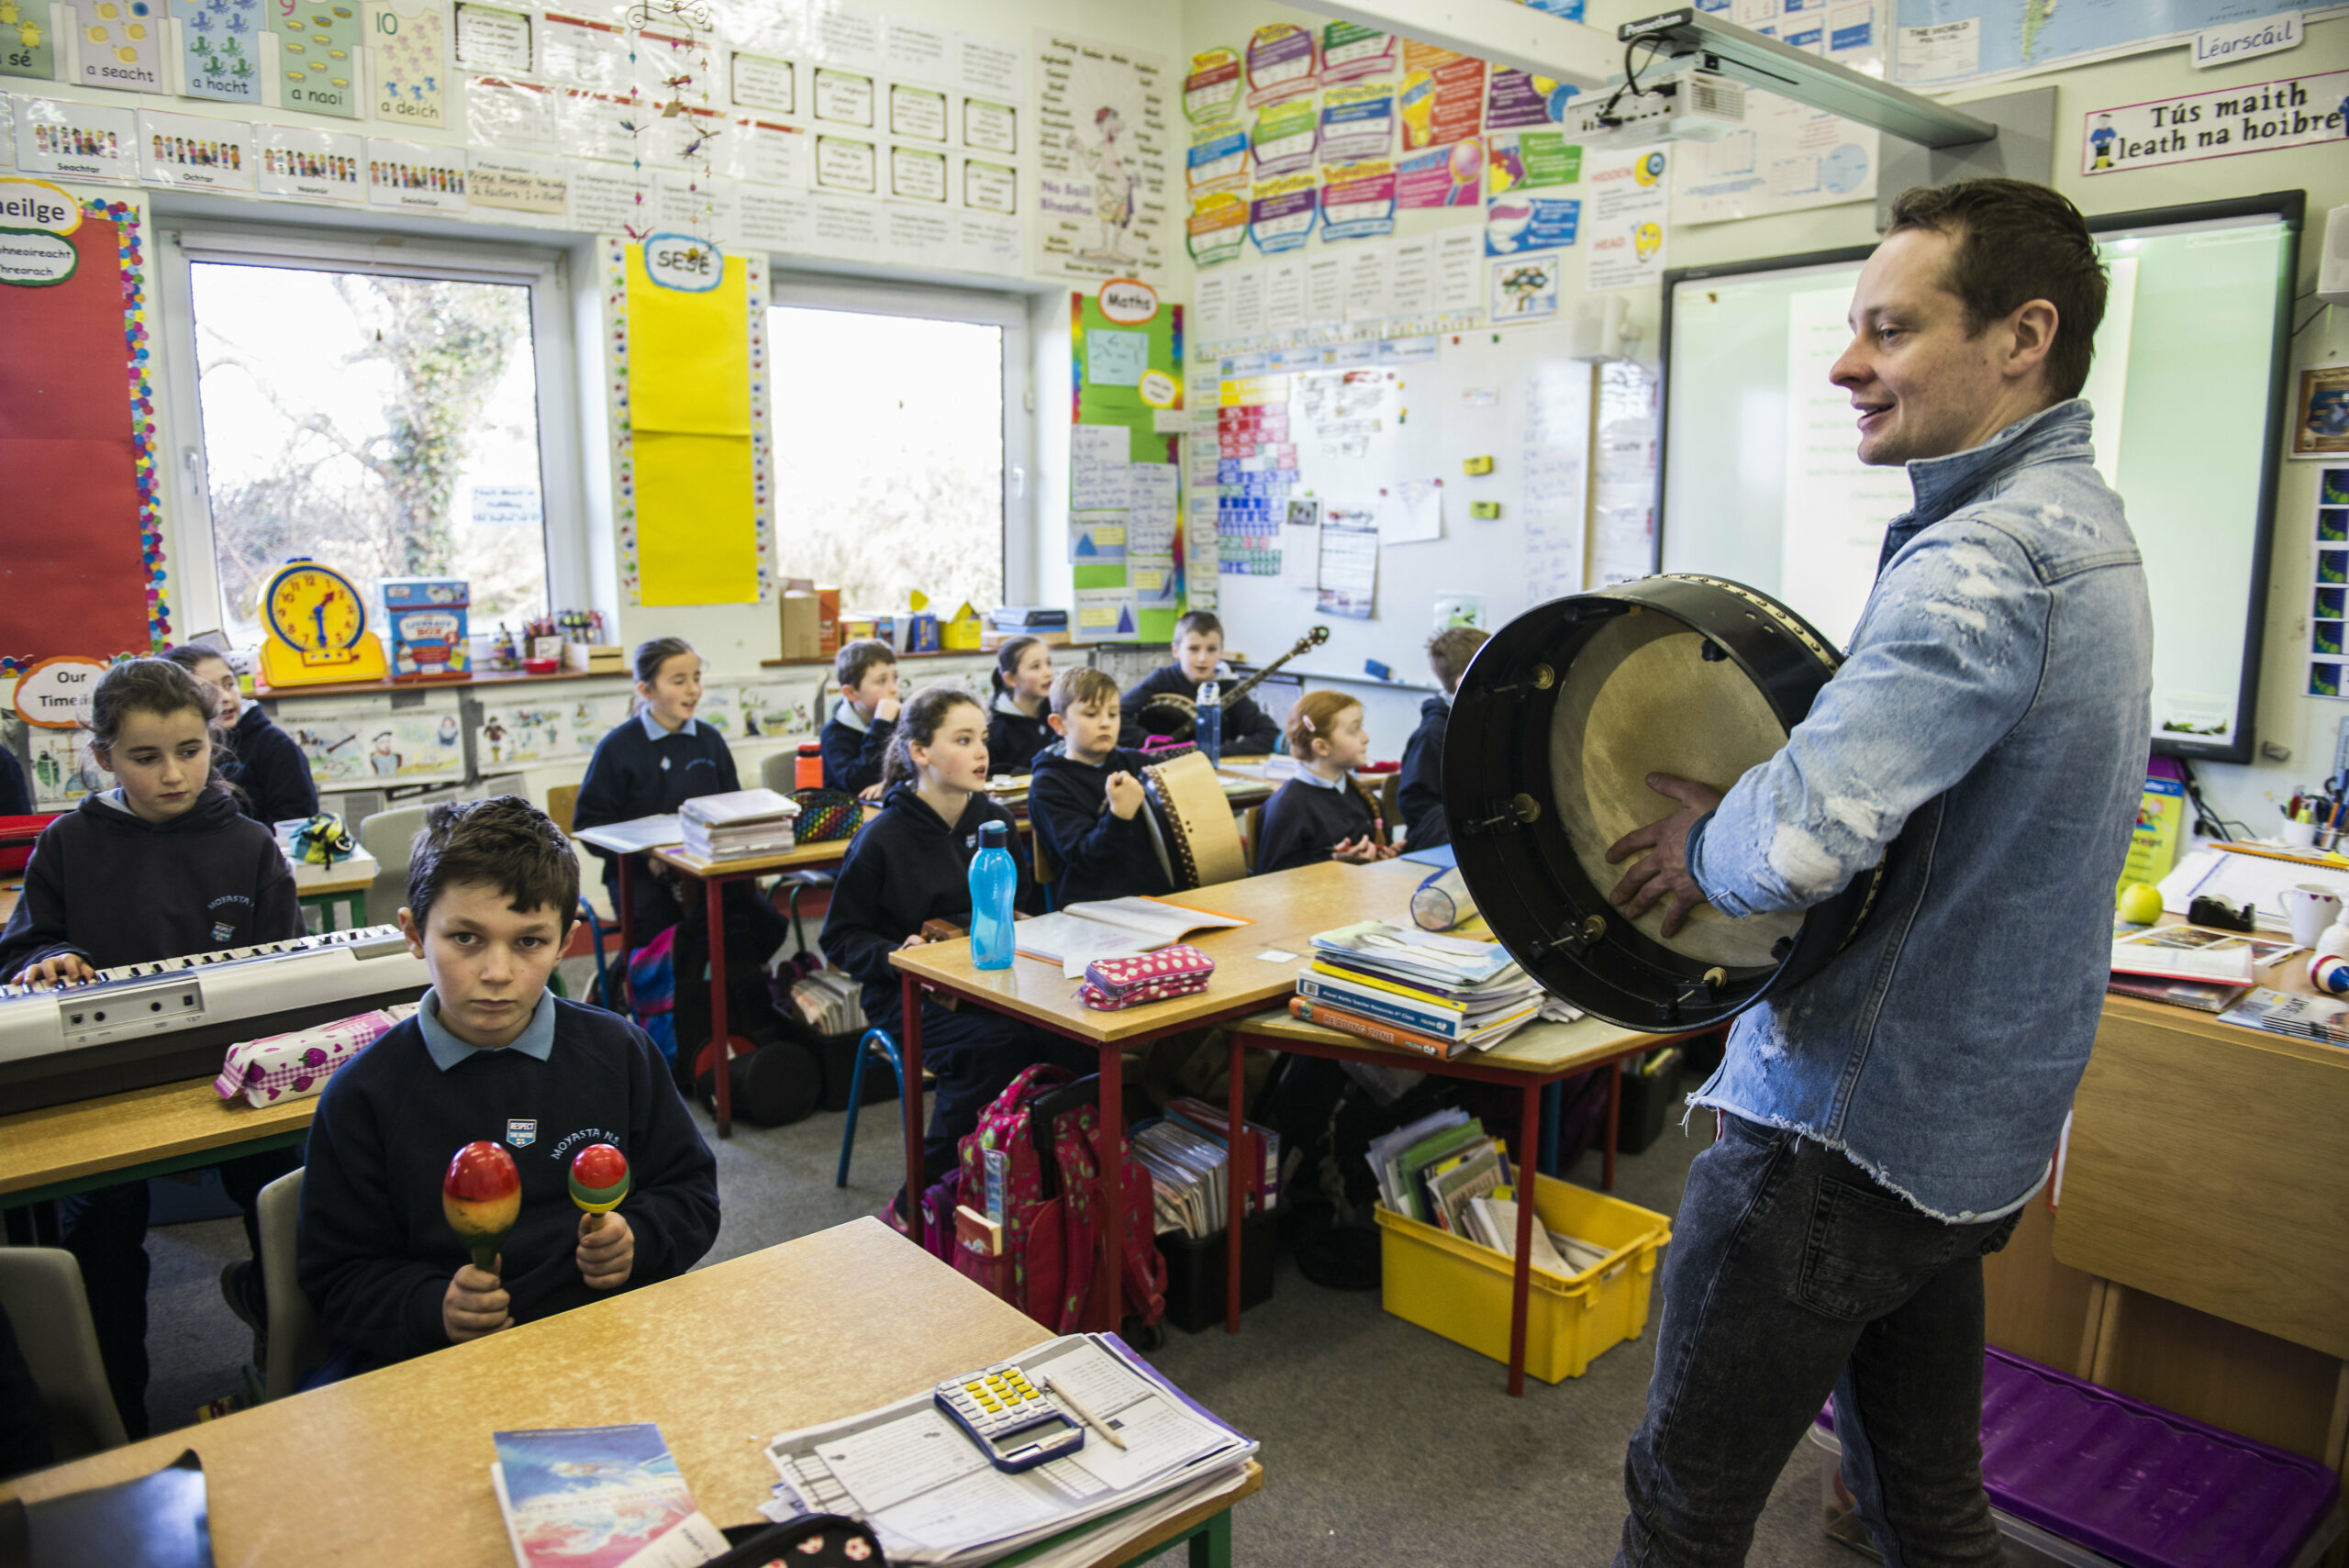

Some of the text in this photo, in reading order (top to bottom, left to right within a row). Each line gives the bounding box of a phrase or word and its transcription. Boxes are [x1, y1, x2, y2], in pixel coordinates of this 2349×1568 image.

[376, 11, 398, 35] 10
[2198, 20, 2294, 61] Léarscáil
[8, 50, 32, 67] sé
[86, 65, 155, 83] a seacht
[193, 76, 250, 95] a hocht
[292, 89, 343, 105] a naoi
[381, 101, 440, 119] a deich
[2151, 81, 2309, 128] Tús maith
[2118, 109, 2343, 160] leath na hoibre
[57, 162, 101, 174] Seachtar
[0, 197, 65, 223] eilge
[0, 246, 72, 259] hneoireacht
[657, 250, 710, 275] SESE
[1107, 293, 1152, 311] Maths
[290, 581, 300, 592] 11
[304, 574, 316, 586] 12
[326, 578, 331, 589] 1
[282, 592, 295, 604] 10
[338, 588, 346, 600] 2
[278, 606, 286, 618] 9
[346, 604, 354, 616] 3
[287, 623, 296, 635] 8
[344, 619, 352, 630] 4
[335, 631, 343, 642] 5
[417, 626, 443, 637] BOX
[302, 632, 310, 645] 7
[56, 671, 87, 684] Our
[38, 694, 93, 707] Timeli
[1322, 1014, 1396, 1044] READING ZONE
[509, 1122, 534, 1130] RESPECT
[551, 1129, 600, 1160] MOYASTA
